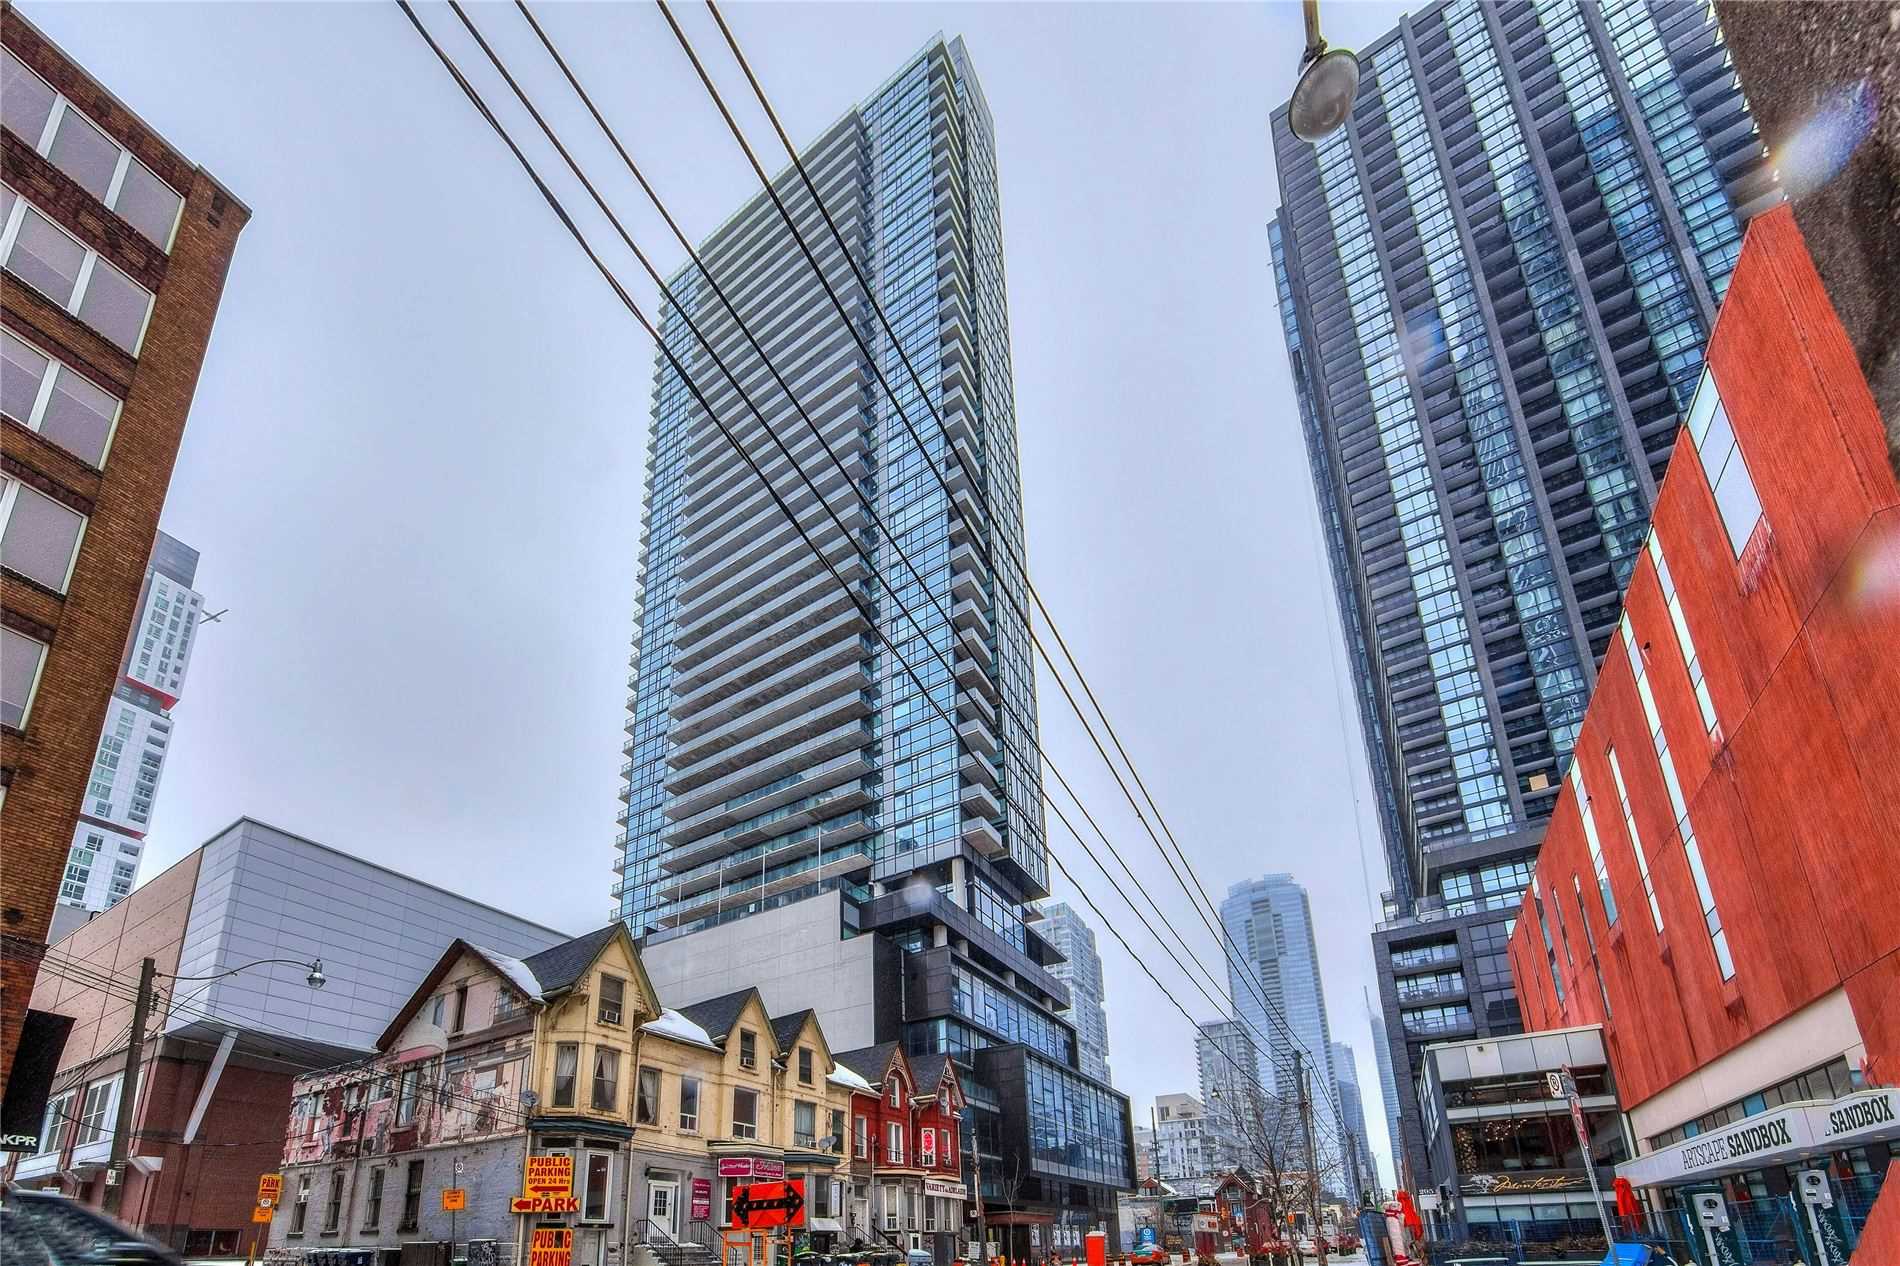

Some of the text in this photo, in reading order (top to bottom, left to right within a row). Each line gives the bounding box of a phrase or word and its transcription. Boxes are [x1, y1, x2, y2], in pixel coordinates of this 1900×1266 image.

[1829, 1094, 1895, 1134] SANDBOX
[1681, 1118, 1792, 1170] ARTSCAPE SANDBOX
[529, 1157, 571, 1167] PUBLIC
[528, 1167, 571, 1177] PARKING
[531, 1198, 578, 1212] PARK
[533, 1230, 572, 1249] PUBIC
[531, 1250, 571, 1266] PARKING
